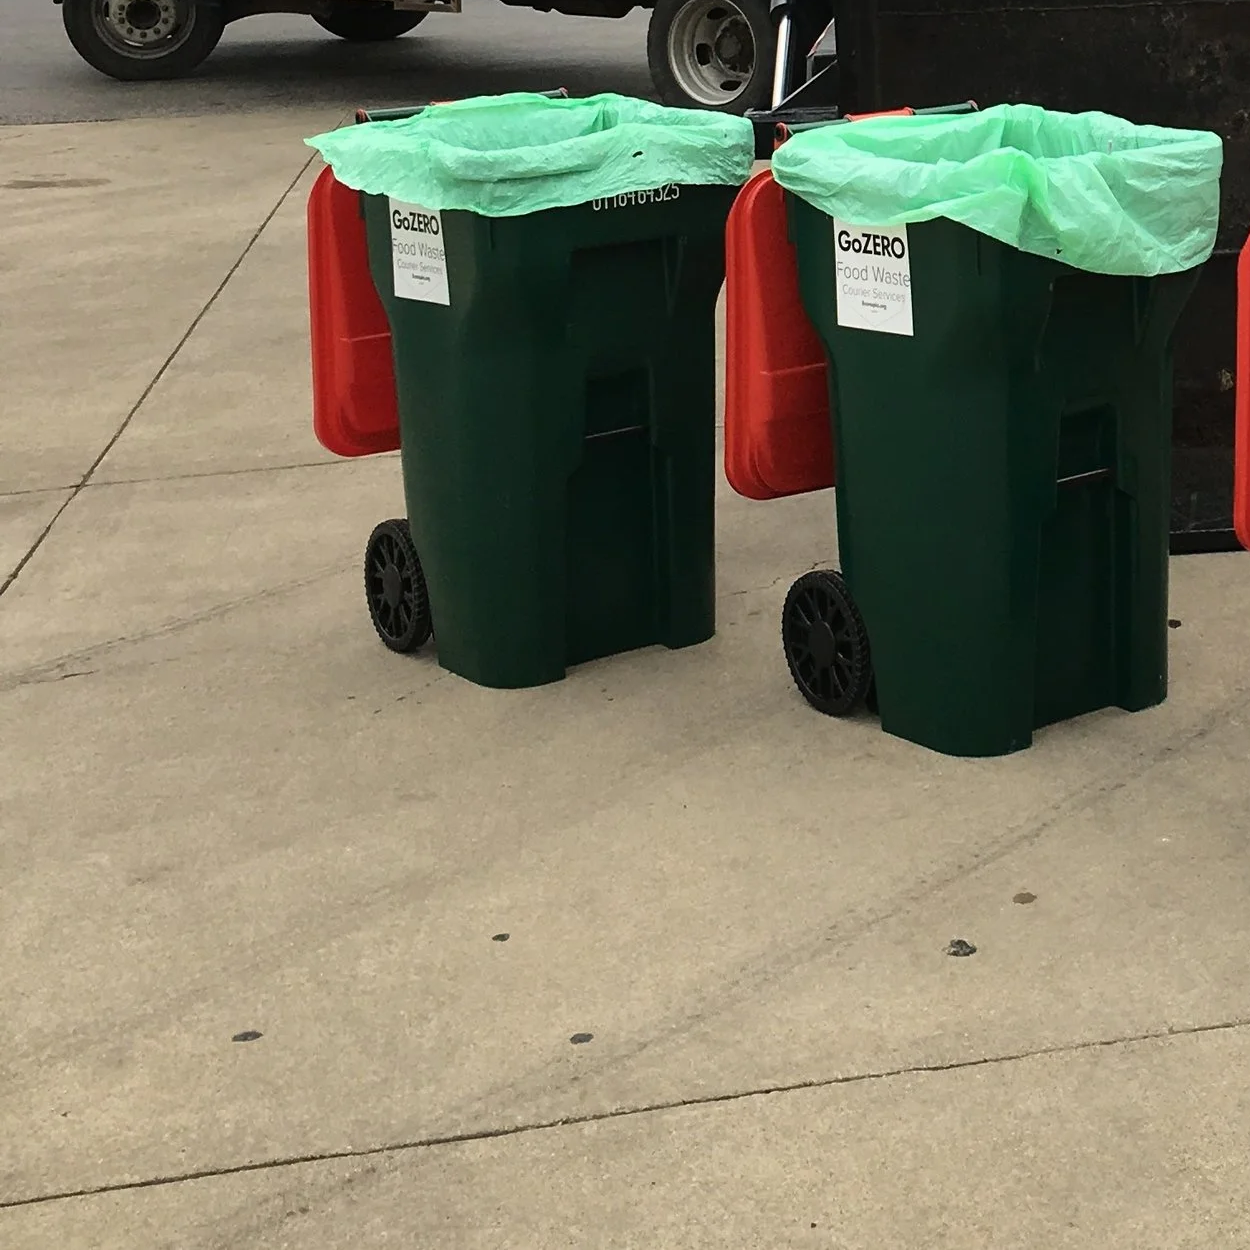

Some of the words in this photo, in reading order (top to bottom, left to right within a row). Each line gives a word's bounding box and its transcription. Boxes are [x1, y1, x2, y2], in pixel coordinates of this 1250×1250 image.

[392, 209, 440, 235] GoZERO
[392, 238, 416, 256] Food
[418, 242, 445, 261] Waste
[838, 230, 906, 259] GoZERO
[837, 261, 868, 281] Food
[872, 266, 911, 287] Waste
[842, 284, 871, 297] Courier
[872, 288, 906, 302] Services
